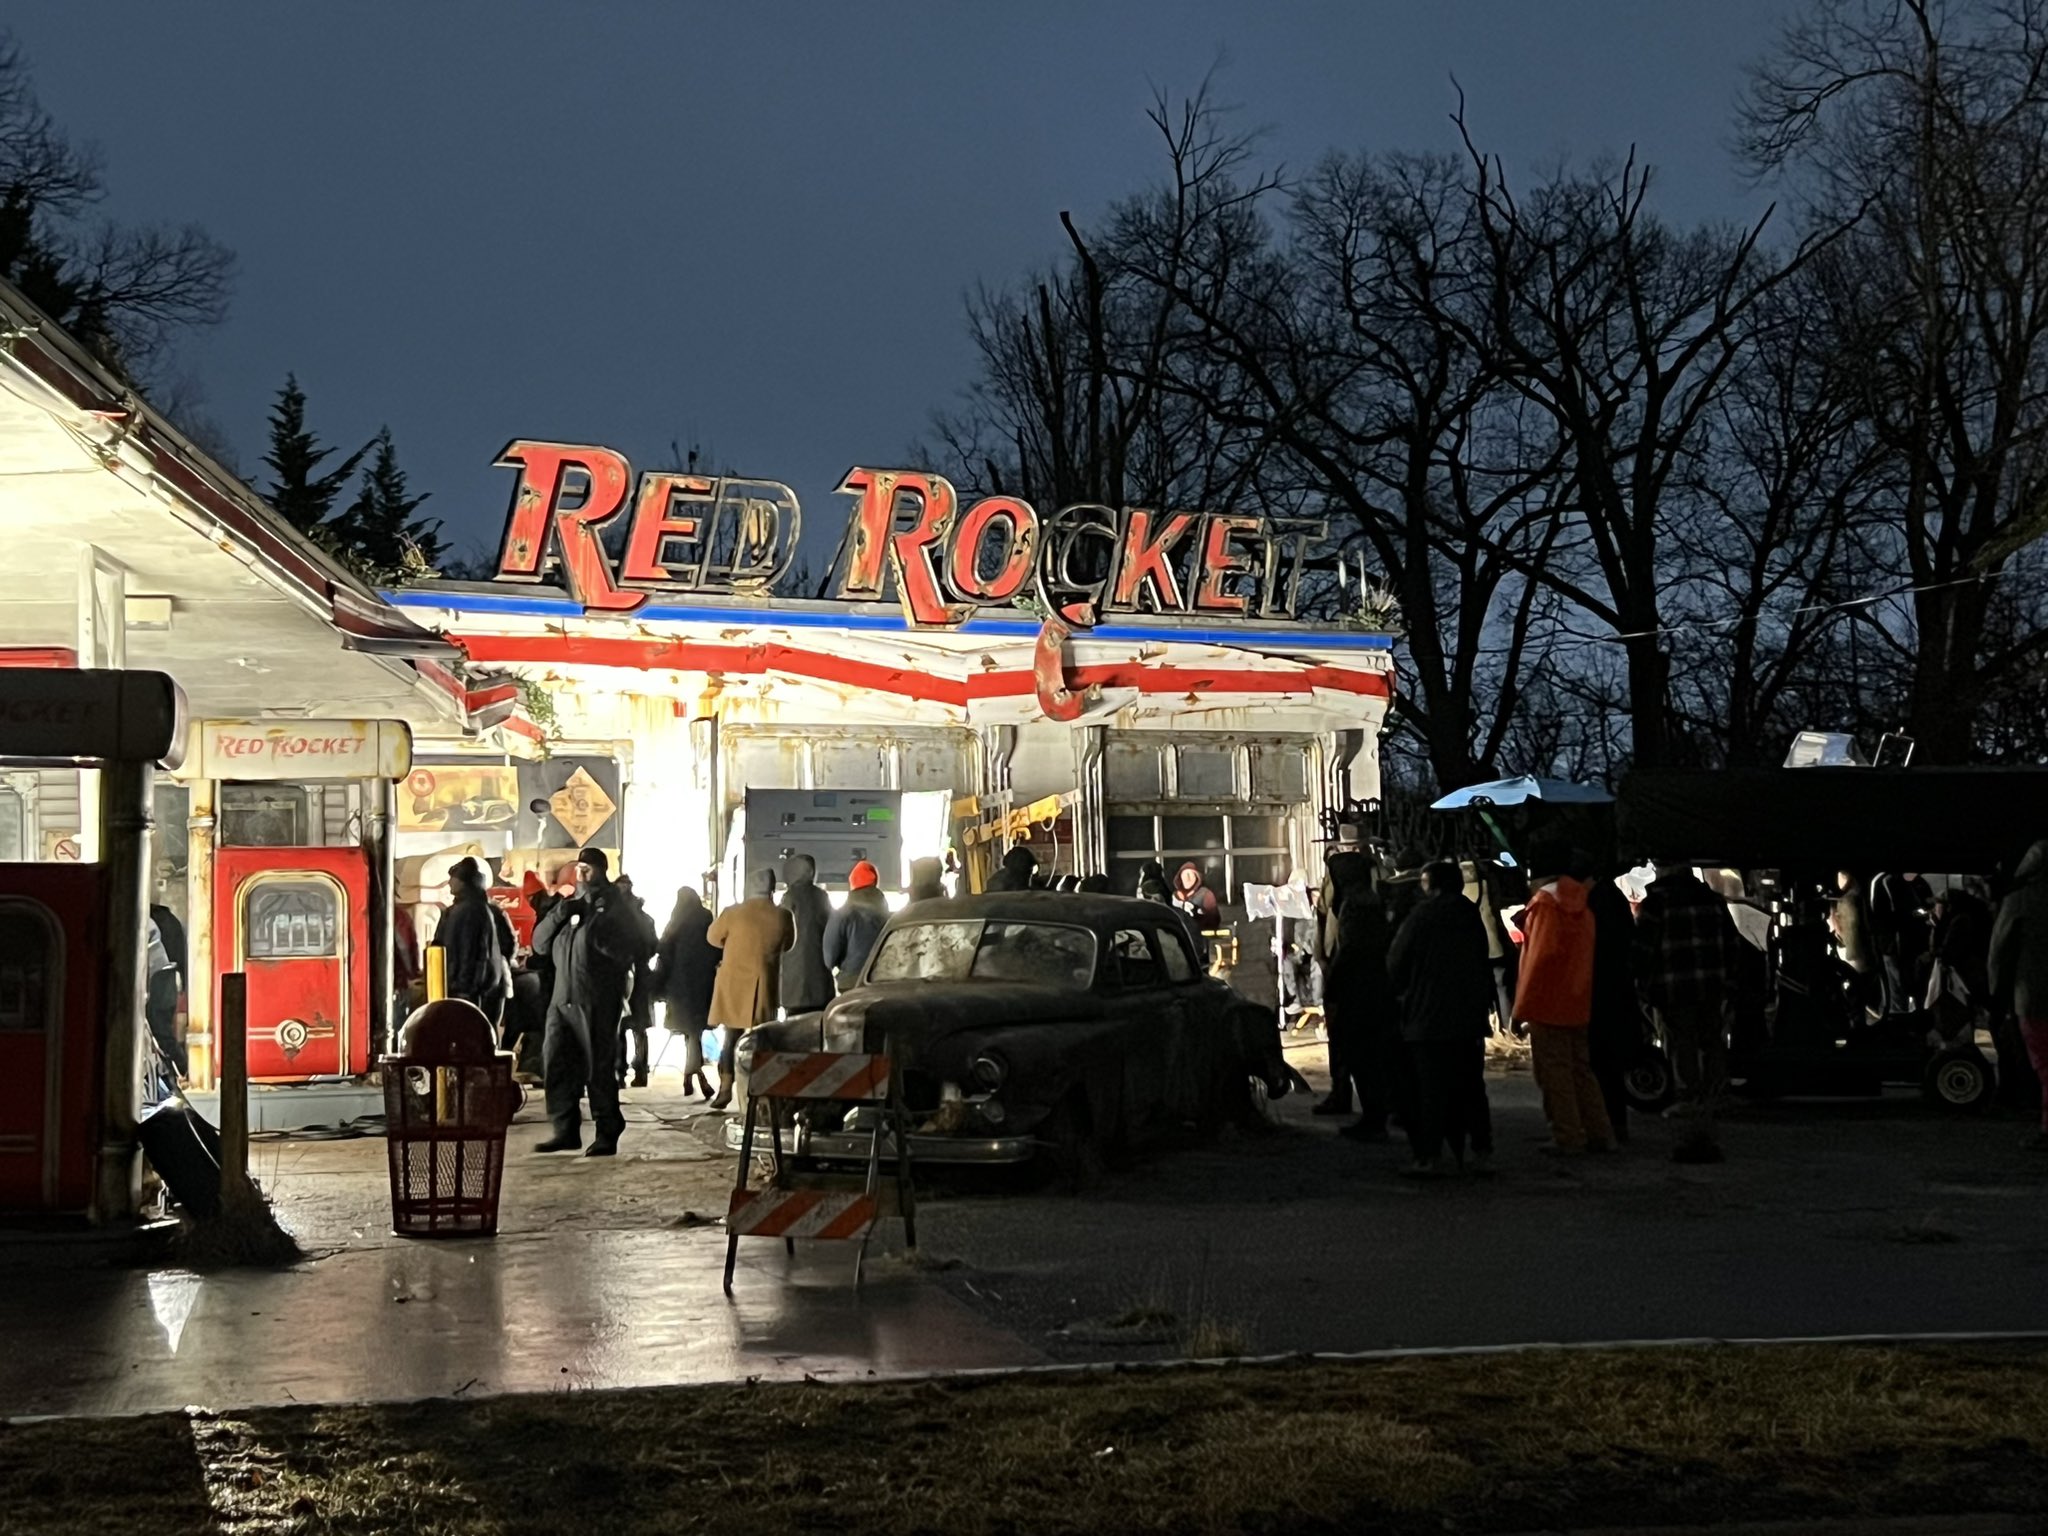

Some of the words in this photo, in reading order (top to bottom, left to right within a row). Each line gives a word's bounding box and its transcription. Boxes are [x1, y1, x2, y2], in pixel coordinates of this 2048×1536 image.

[491, 438, 801, 618] RED
[832, 467, 1329, 632] ROCKET
[215, 735, 265, 758] RED
[269, 735, 366, 758] ROCKET
